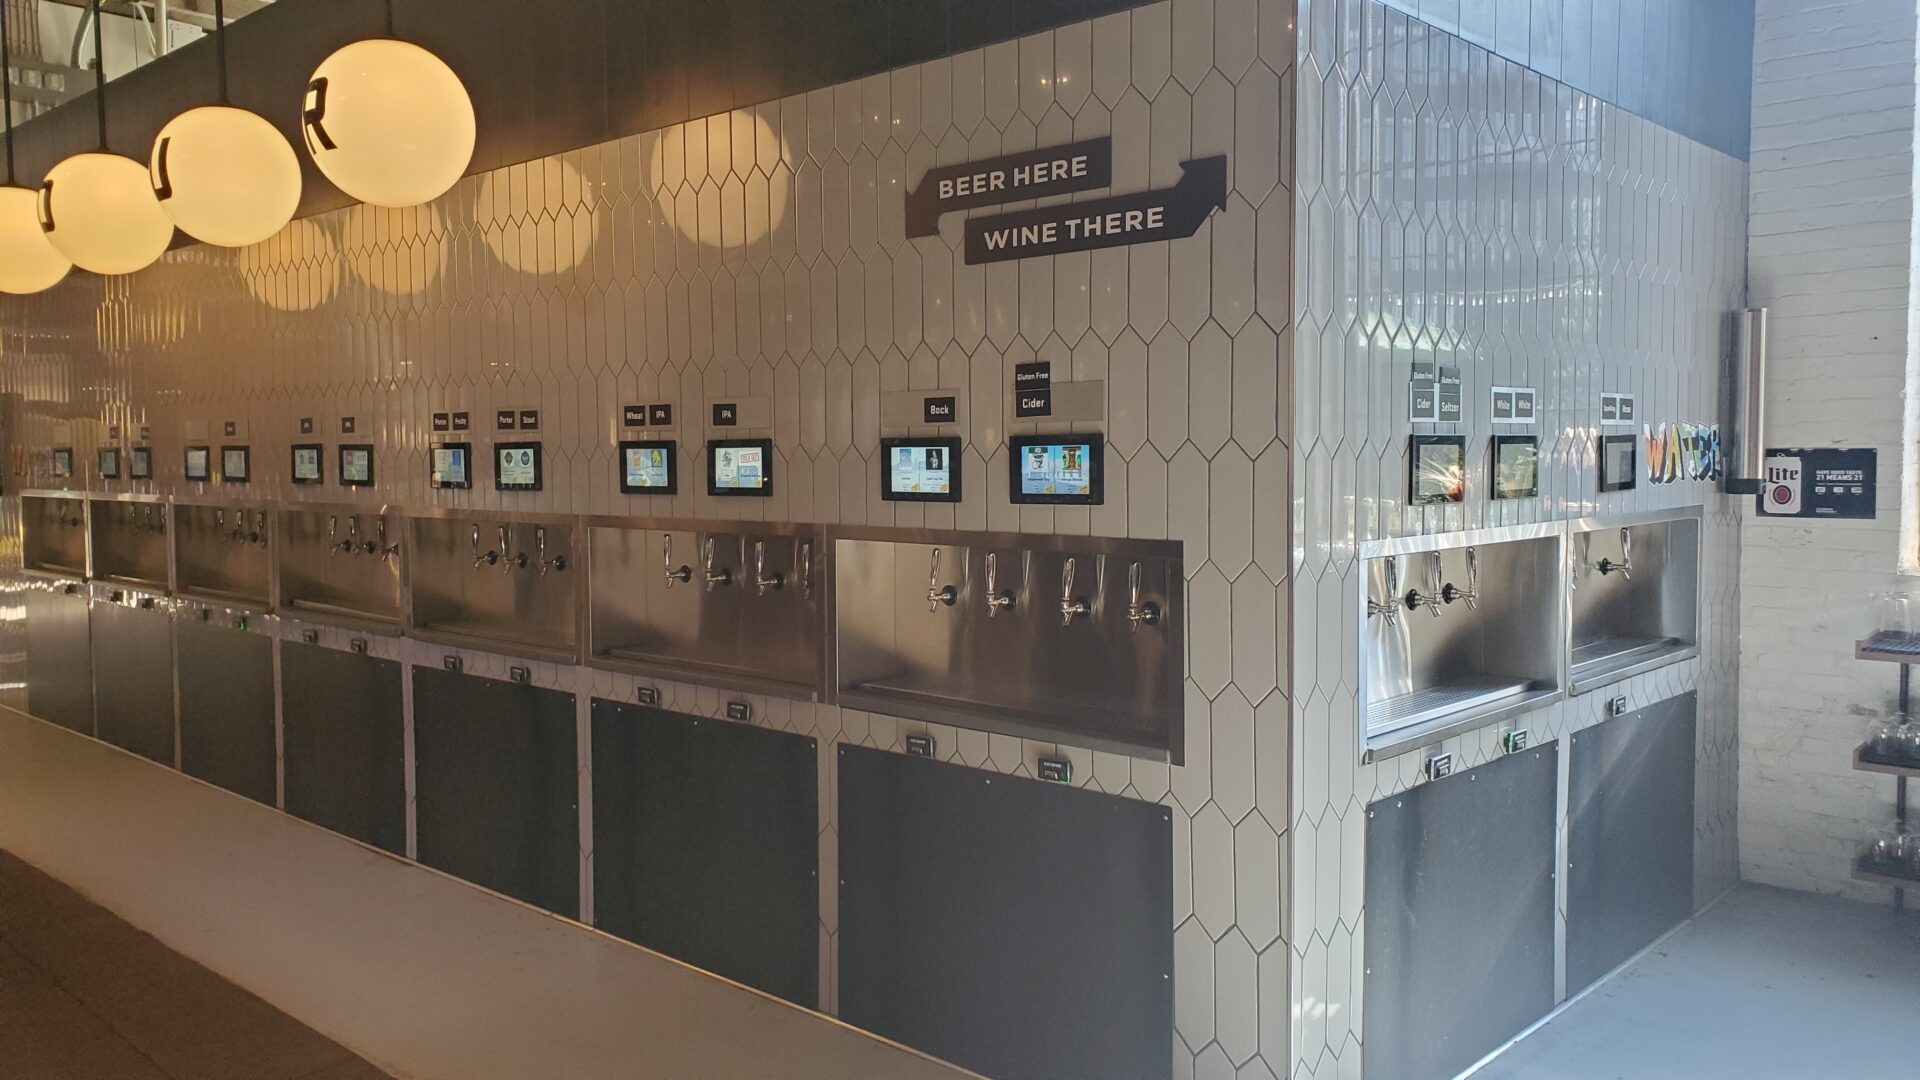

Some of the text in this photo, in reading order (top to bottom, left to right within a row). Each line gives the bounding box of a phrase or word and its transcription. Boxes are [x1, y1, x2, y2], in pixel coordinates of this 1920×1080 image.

[302, 77, 337, 155] R
[938, 156, 1087, 199] BEER HERE
[983, 206, 1165, 251] WINE THERE
[1022, 398, 1045, 408] Cider
[1416, 398, 1430, 408] Cider
[1441, 402, 1459, 412] Seltzer
[1497, 400, 1510, 410] White
[1518, 400, 1530, 410] White
[722, 410, 732, 418] IPA
[930, 404, 949, 415] Bock
[626, 411, 643, 420] Wheat
[1641, 420, 1722, 486] WATER
[1768, 467, 1798, 484] Lite
